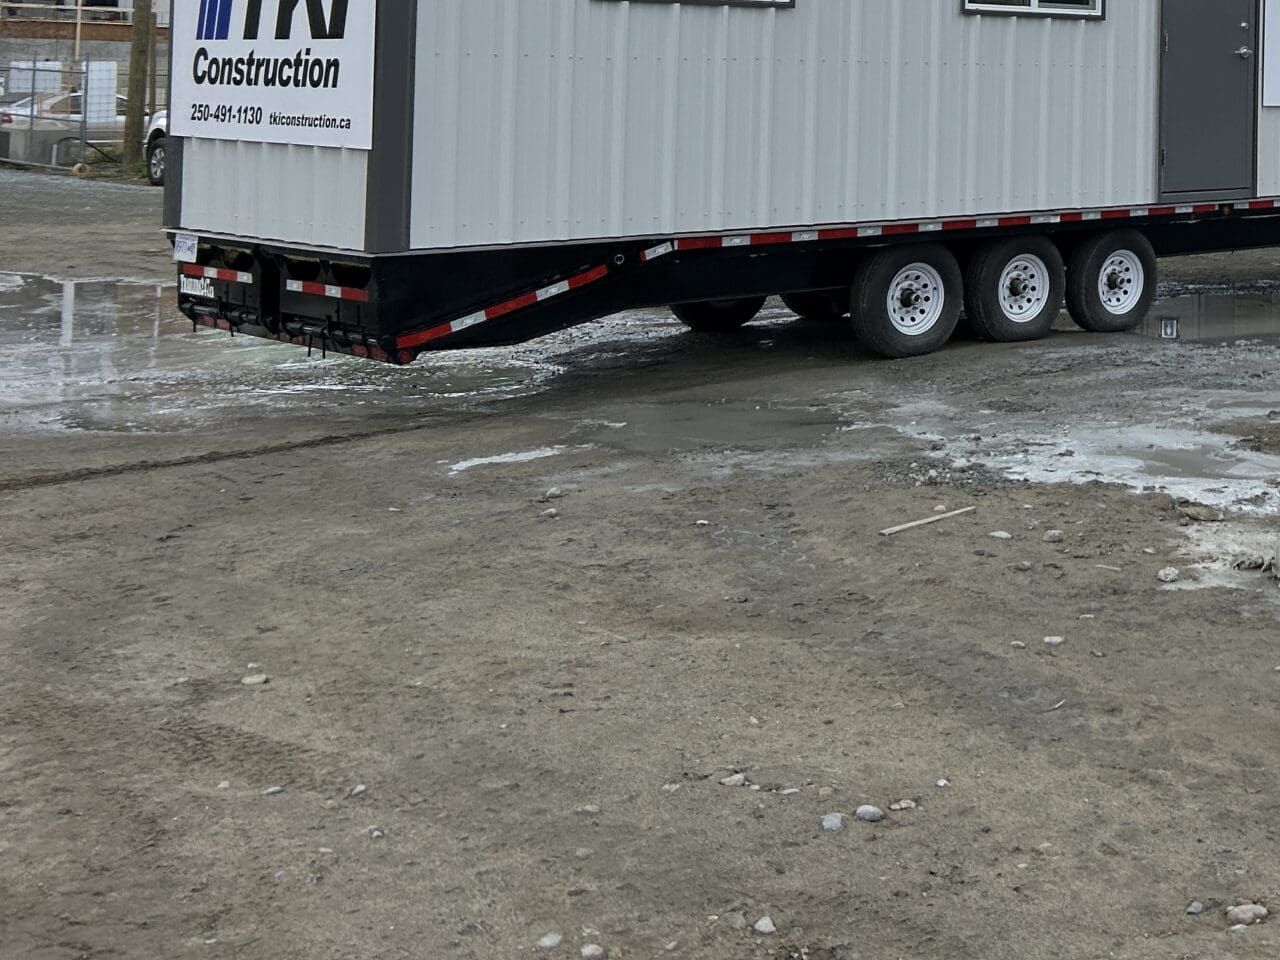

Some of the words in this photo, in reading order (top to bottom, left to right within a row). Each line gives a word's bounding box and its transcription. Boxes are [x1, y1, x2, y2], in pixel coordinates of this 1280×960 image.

[193, 47, 340, 88] Construction
[191, 103, 263, 125] 250-491-1130
[269, 111, 351, 130] tkiconstruction.ca
